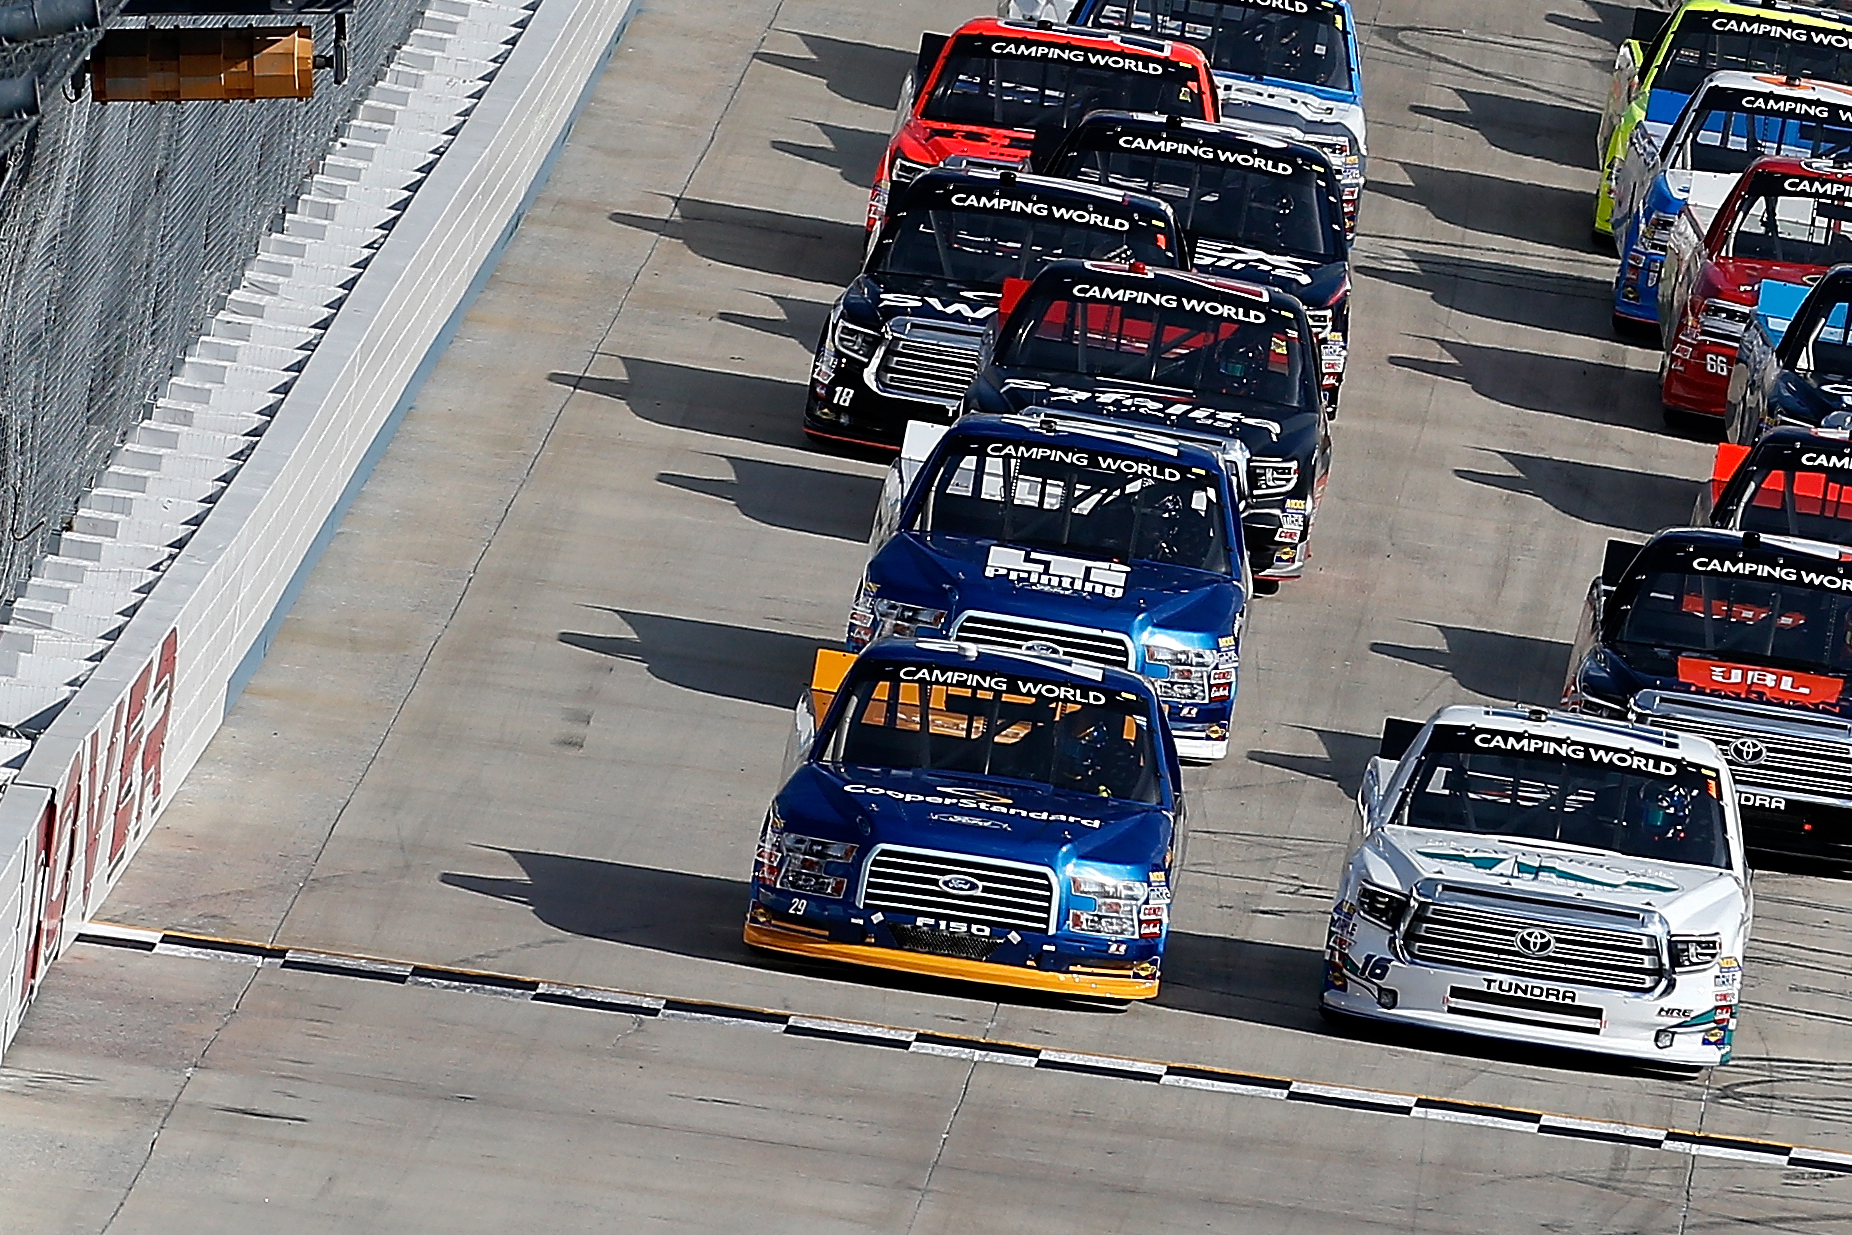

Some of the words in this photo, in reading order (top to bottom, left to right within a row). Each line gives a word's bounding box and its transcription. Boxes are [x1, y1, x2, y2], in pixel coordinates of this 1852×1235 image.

[1712, 18, 1807, 42] CAMPING
[991, 42, 1084, 64] CAMPING
[1087, 52, 1163, 76] WORLD
[1741, 96, 1829, 118] CAMPING
[1118, 136, 1214, 161] CAMPING
[1217, 151, 1292, 176] WORLD
[951, 194, 1049, 217] CAMPING
[1052, 208, 1129, 232] WORLD
[1072, 284, 1179, 309] CAMPING
[1181, 299, 1266, 325] WORLD
[1706, 353, 1728, 376] 66
[832, 386, 853, 408] 18
[987, 443, 1088, 466] CAMPING
[1097, 456, 1180, 482] WORLD
[1692, 558, 1797, 581] CAMPING
[899, 666, 1008, 692] CAMPING
[1016, 680, 1106, 706] WORLD
[1710, 666, 1811, 695] JBL
[1473, 734, 1584, 761] CAMPING
[1588, 747, 1677, 776] WORLD
[788, 897, 808, 916] 29
[915, 916, 991, 937] F150
[1357, 953, 1395, 981] 16
[1482, 978, 1577, 1004] TUNDRA
